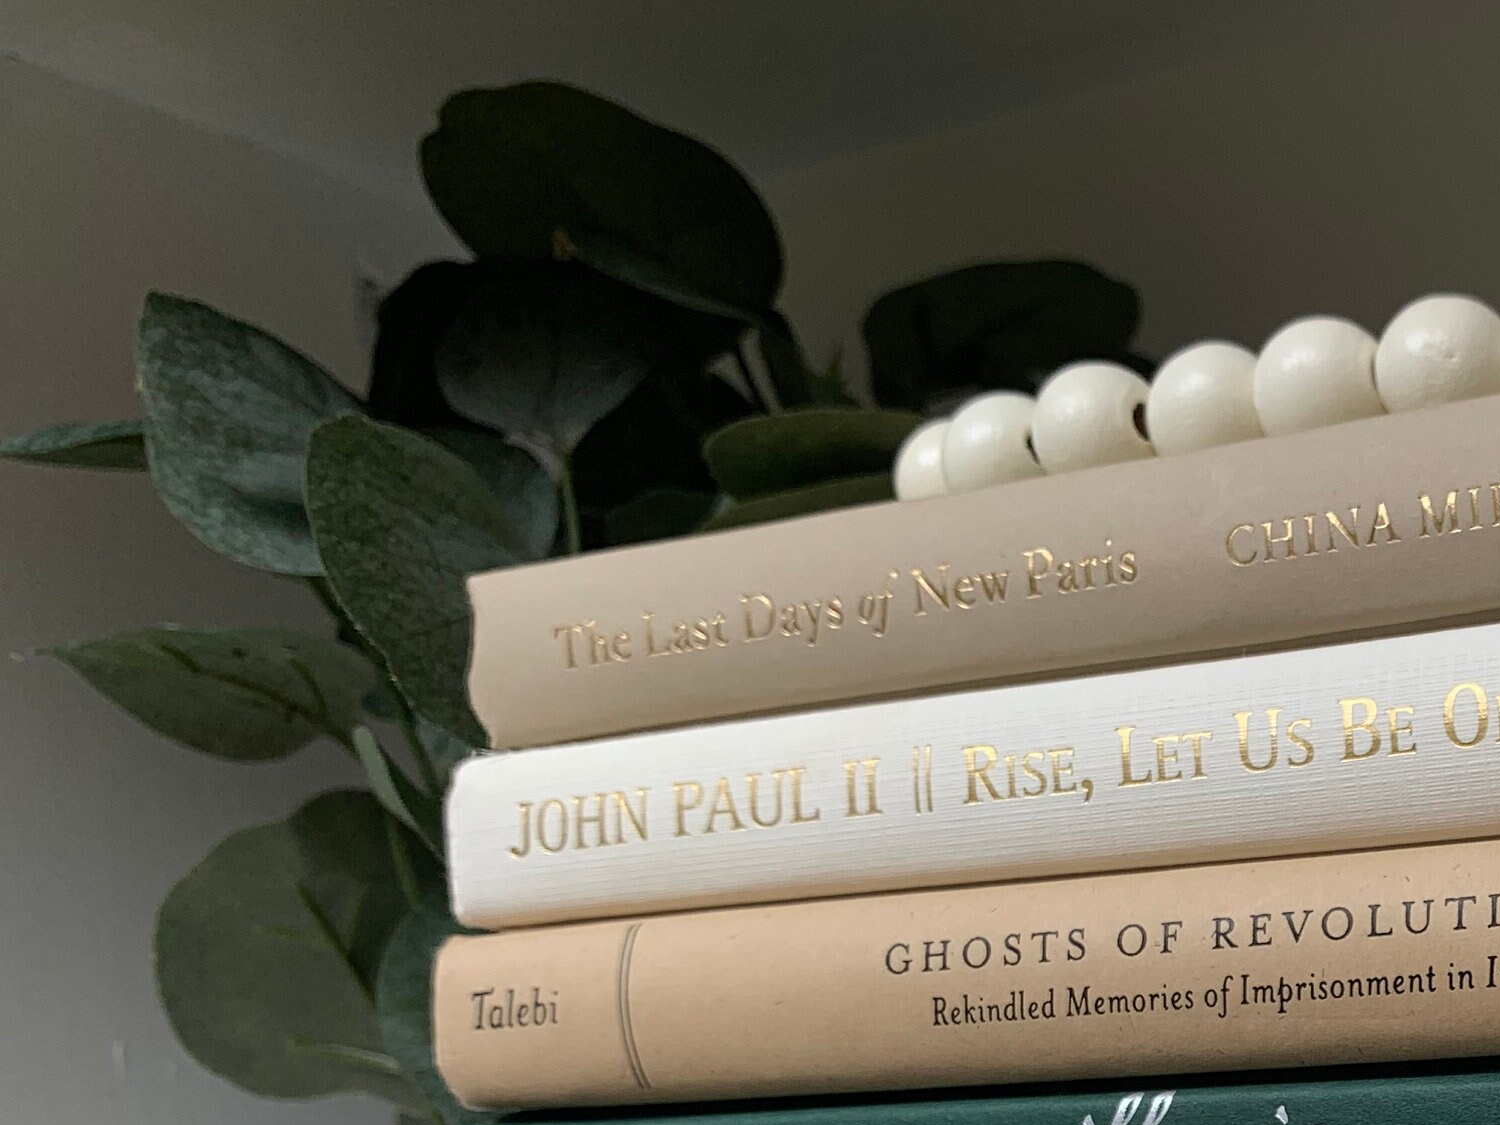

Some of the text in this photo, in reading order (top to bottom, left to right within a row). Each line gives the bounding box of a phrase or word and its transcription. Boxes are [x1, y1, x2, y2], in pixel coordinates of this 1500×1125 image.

[1225, 502, 1401, 568] CHINA
[555, 540, 1139, 671] The Last Days of New Paris
[508, 757, 883, 860] JOHN PAUL II
[885, 927, 1088, 976] GHOSTS
[1116, 921, 1184, 957] OF
[471, 988, 558, 1030] Talebi
[933, 988, 1056, 1027] Rekindled
[1066, 984, 1195, 1019] Memories
[1203, 975, 1233, 1018] of
[1240, 966, 1436, 1014] Imprisonment
[1447, 961, 1474, 990] in
